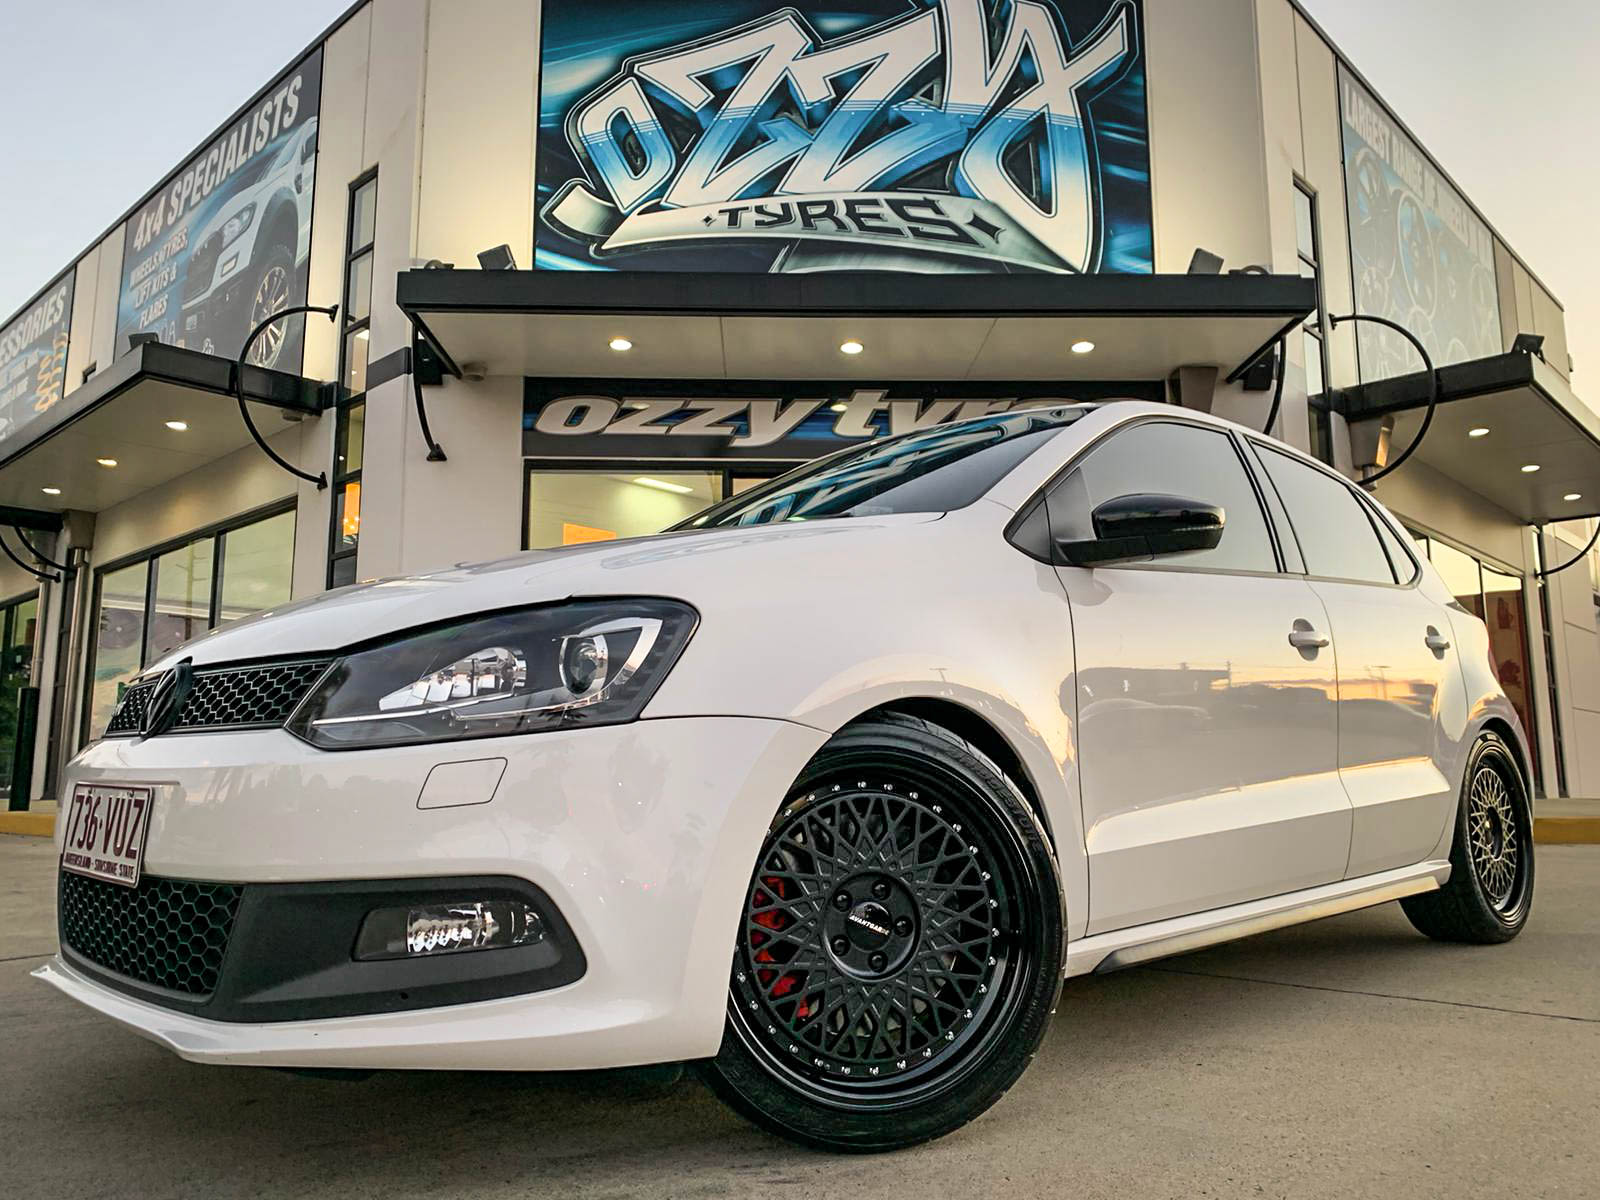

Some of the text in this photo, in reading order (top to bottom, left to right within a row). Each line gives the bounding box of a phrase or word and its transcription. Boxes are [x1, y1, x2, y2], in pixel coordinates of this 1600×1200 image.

[167, 75, 302, 226] SPECIALISTS
[717, 197, 976, 245] TYRES
[533, 389, 1145, 446] ozzy tyr
